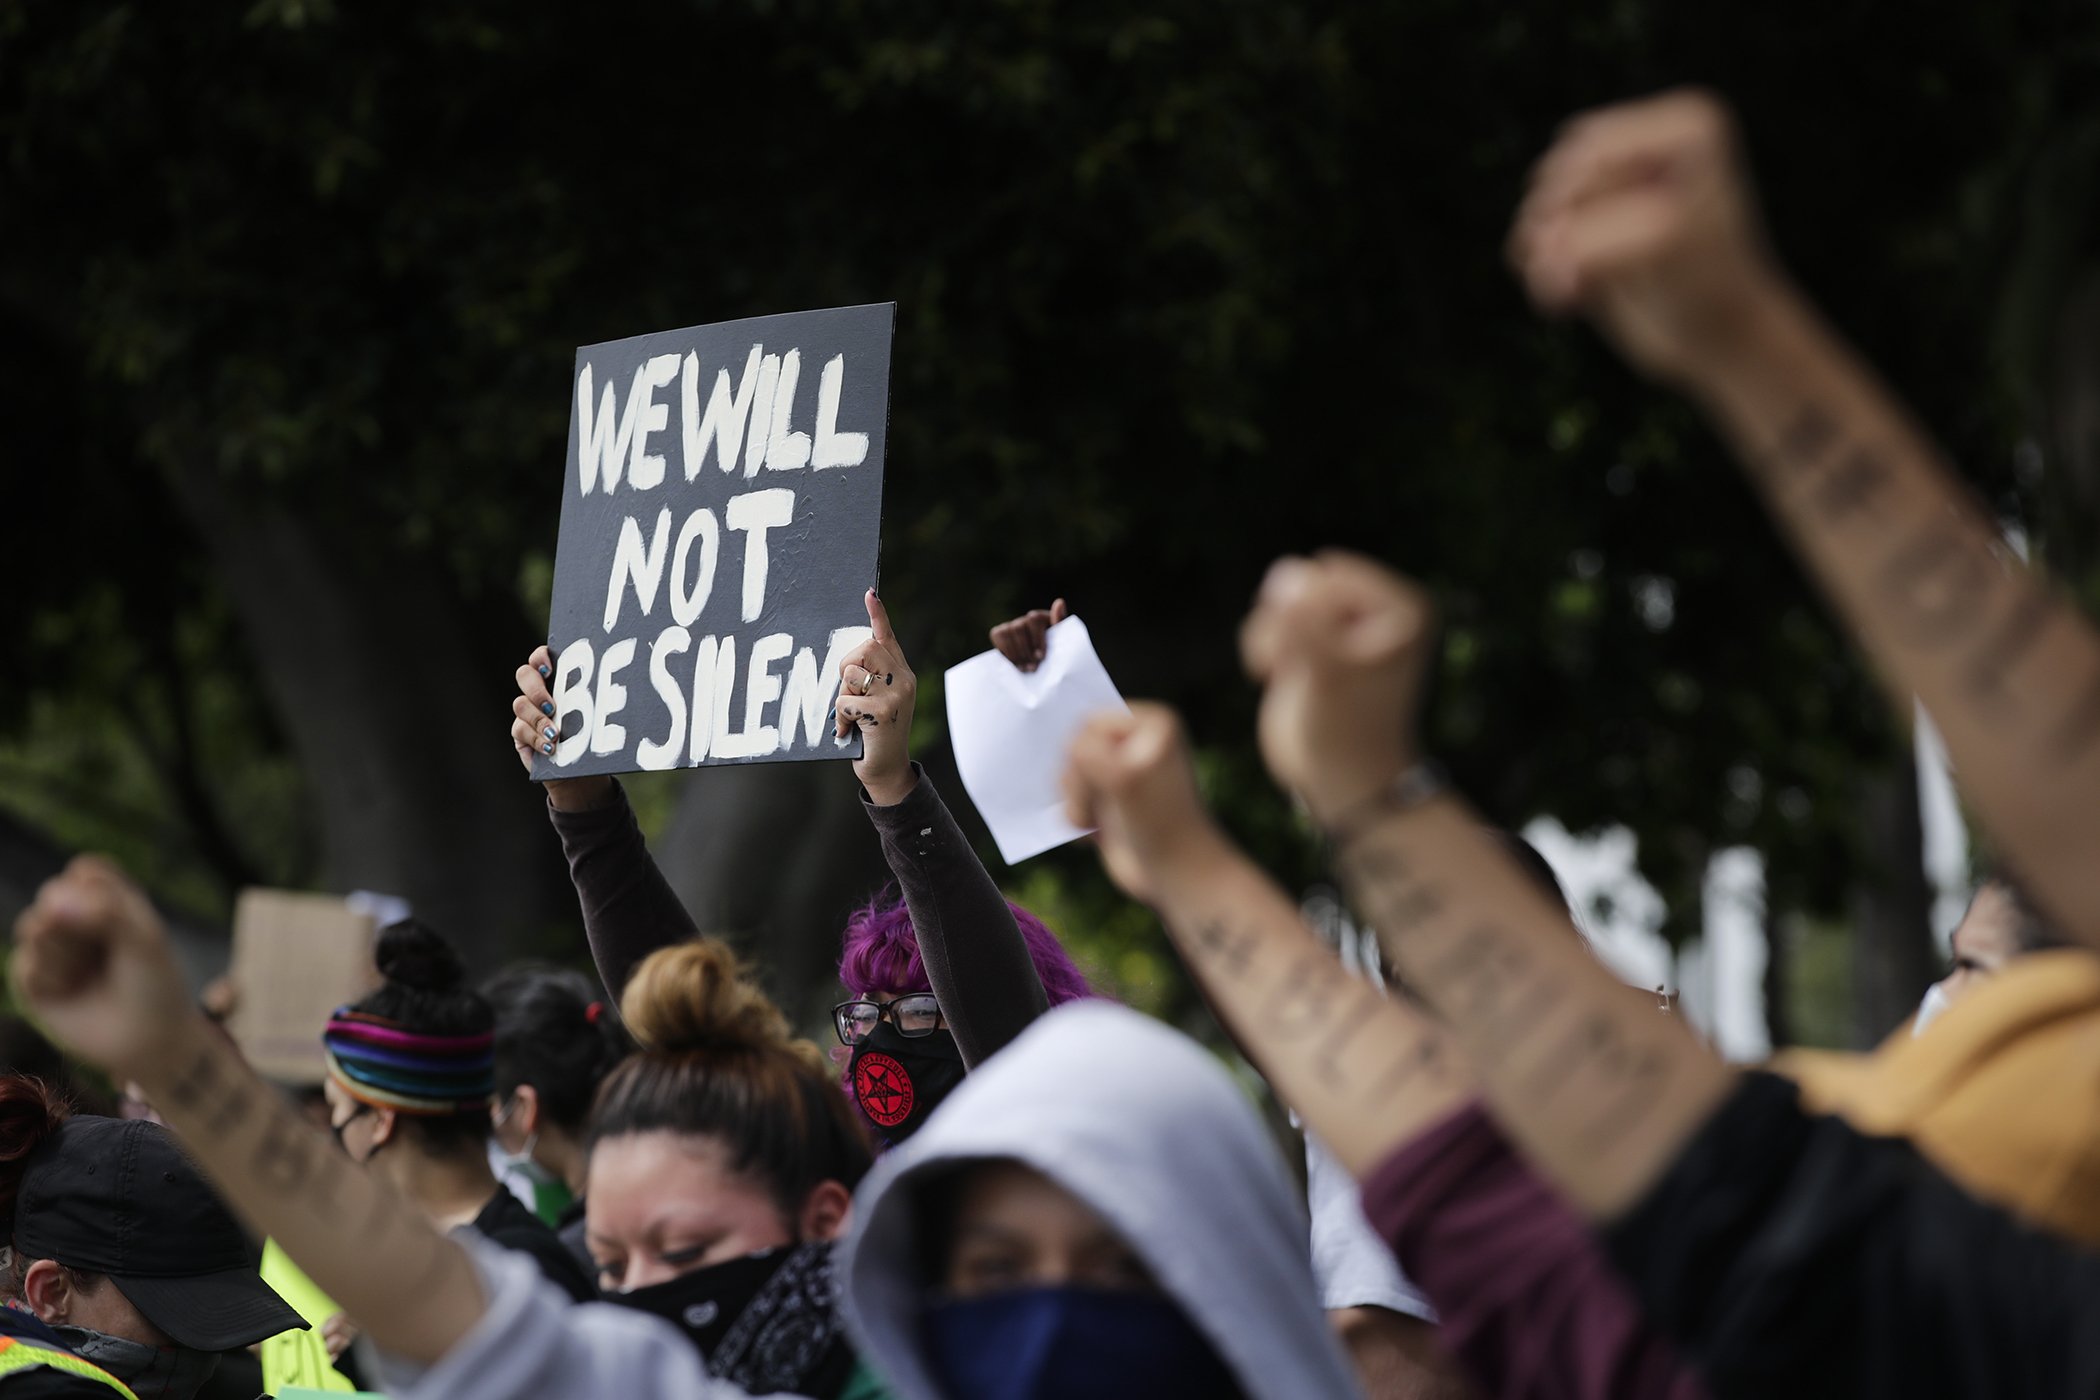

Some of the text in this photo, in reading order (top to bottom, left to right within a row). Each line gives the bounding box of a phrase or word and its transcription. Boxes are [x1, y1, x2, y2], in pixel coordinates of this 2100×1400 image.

[577, 343, 869, 498] WE WILL
[603, 488, 795, 633] NOT
[552, 638, 637, 766] BE
